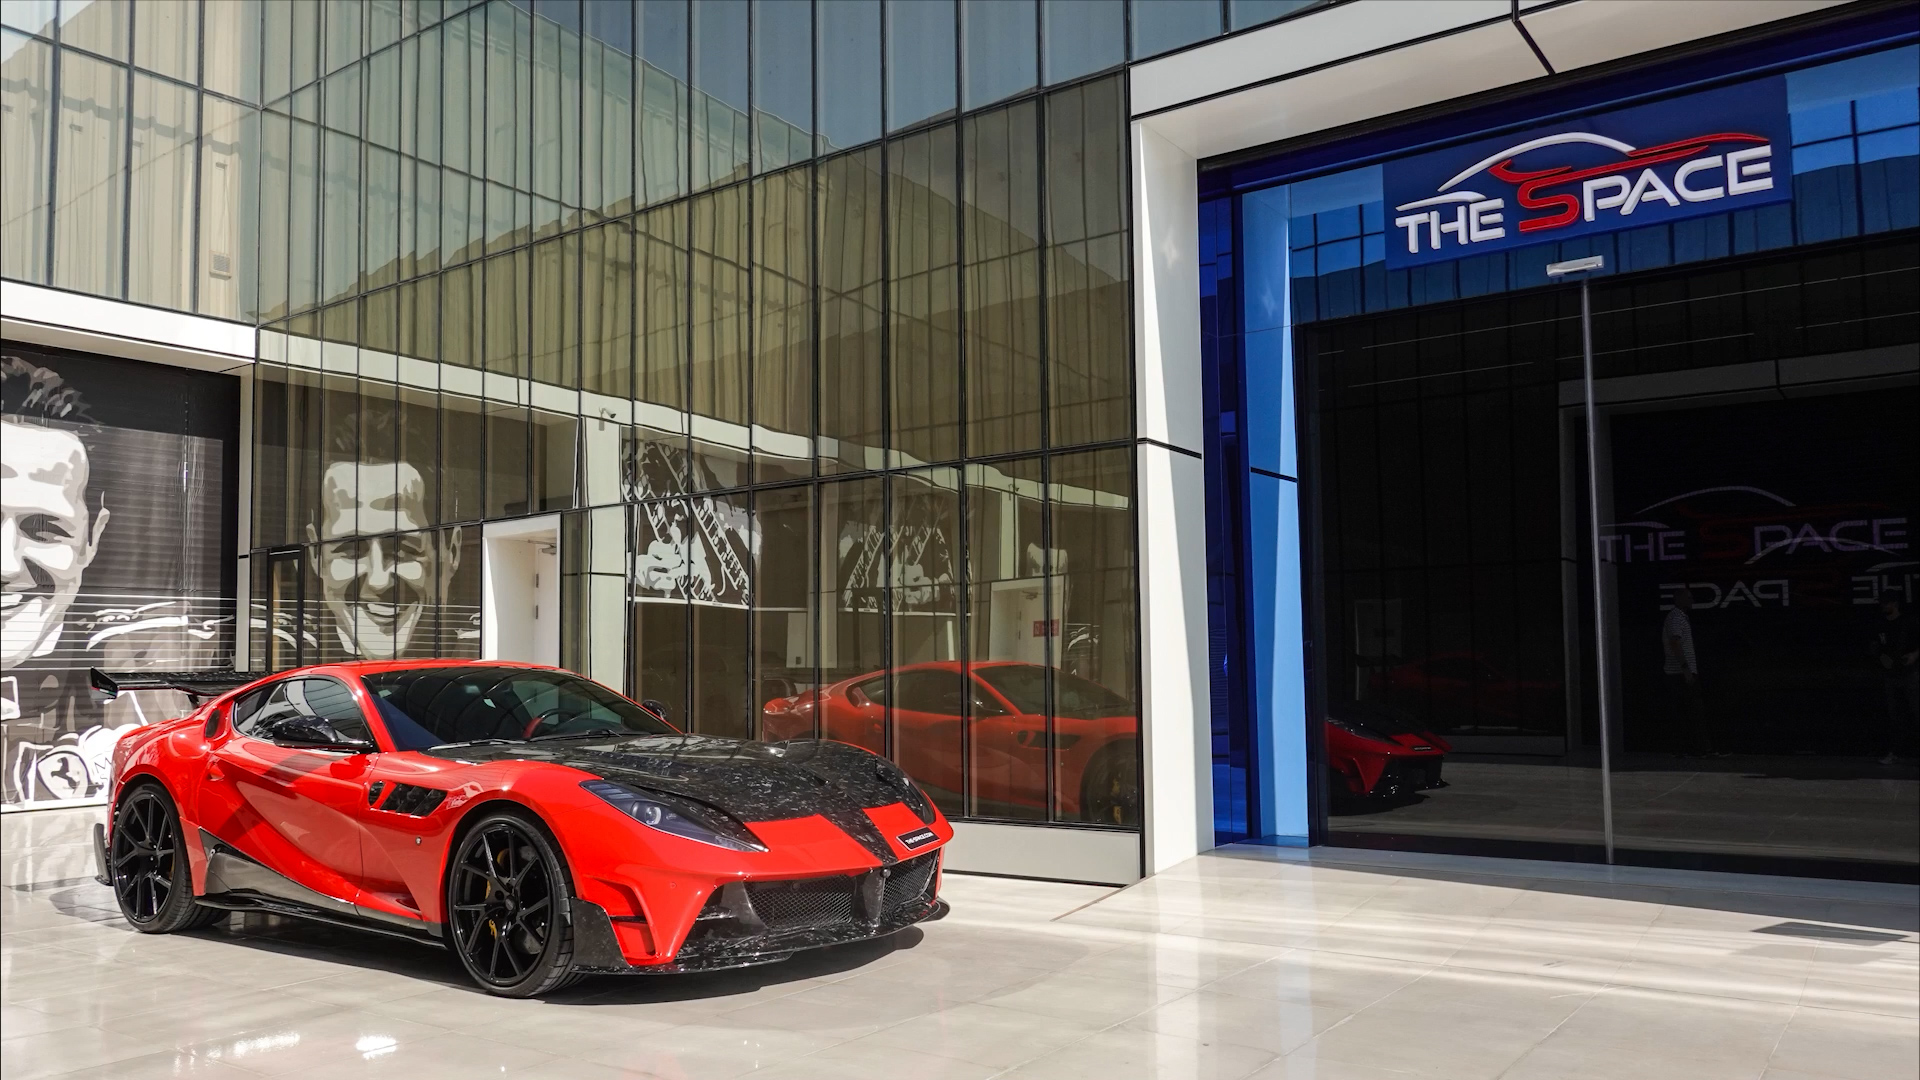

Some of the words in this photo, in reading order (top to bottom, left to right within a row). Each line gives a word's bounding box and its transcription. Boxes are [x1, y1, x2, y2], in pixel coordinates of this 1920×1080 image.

[1395, 198, 1505, 253] THE
[1517, 144, 1774, 233] SPACE
[1599, 530, 1686, 563] THE
[1699, 517, 1908, 559] SPACE
